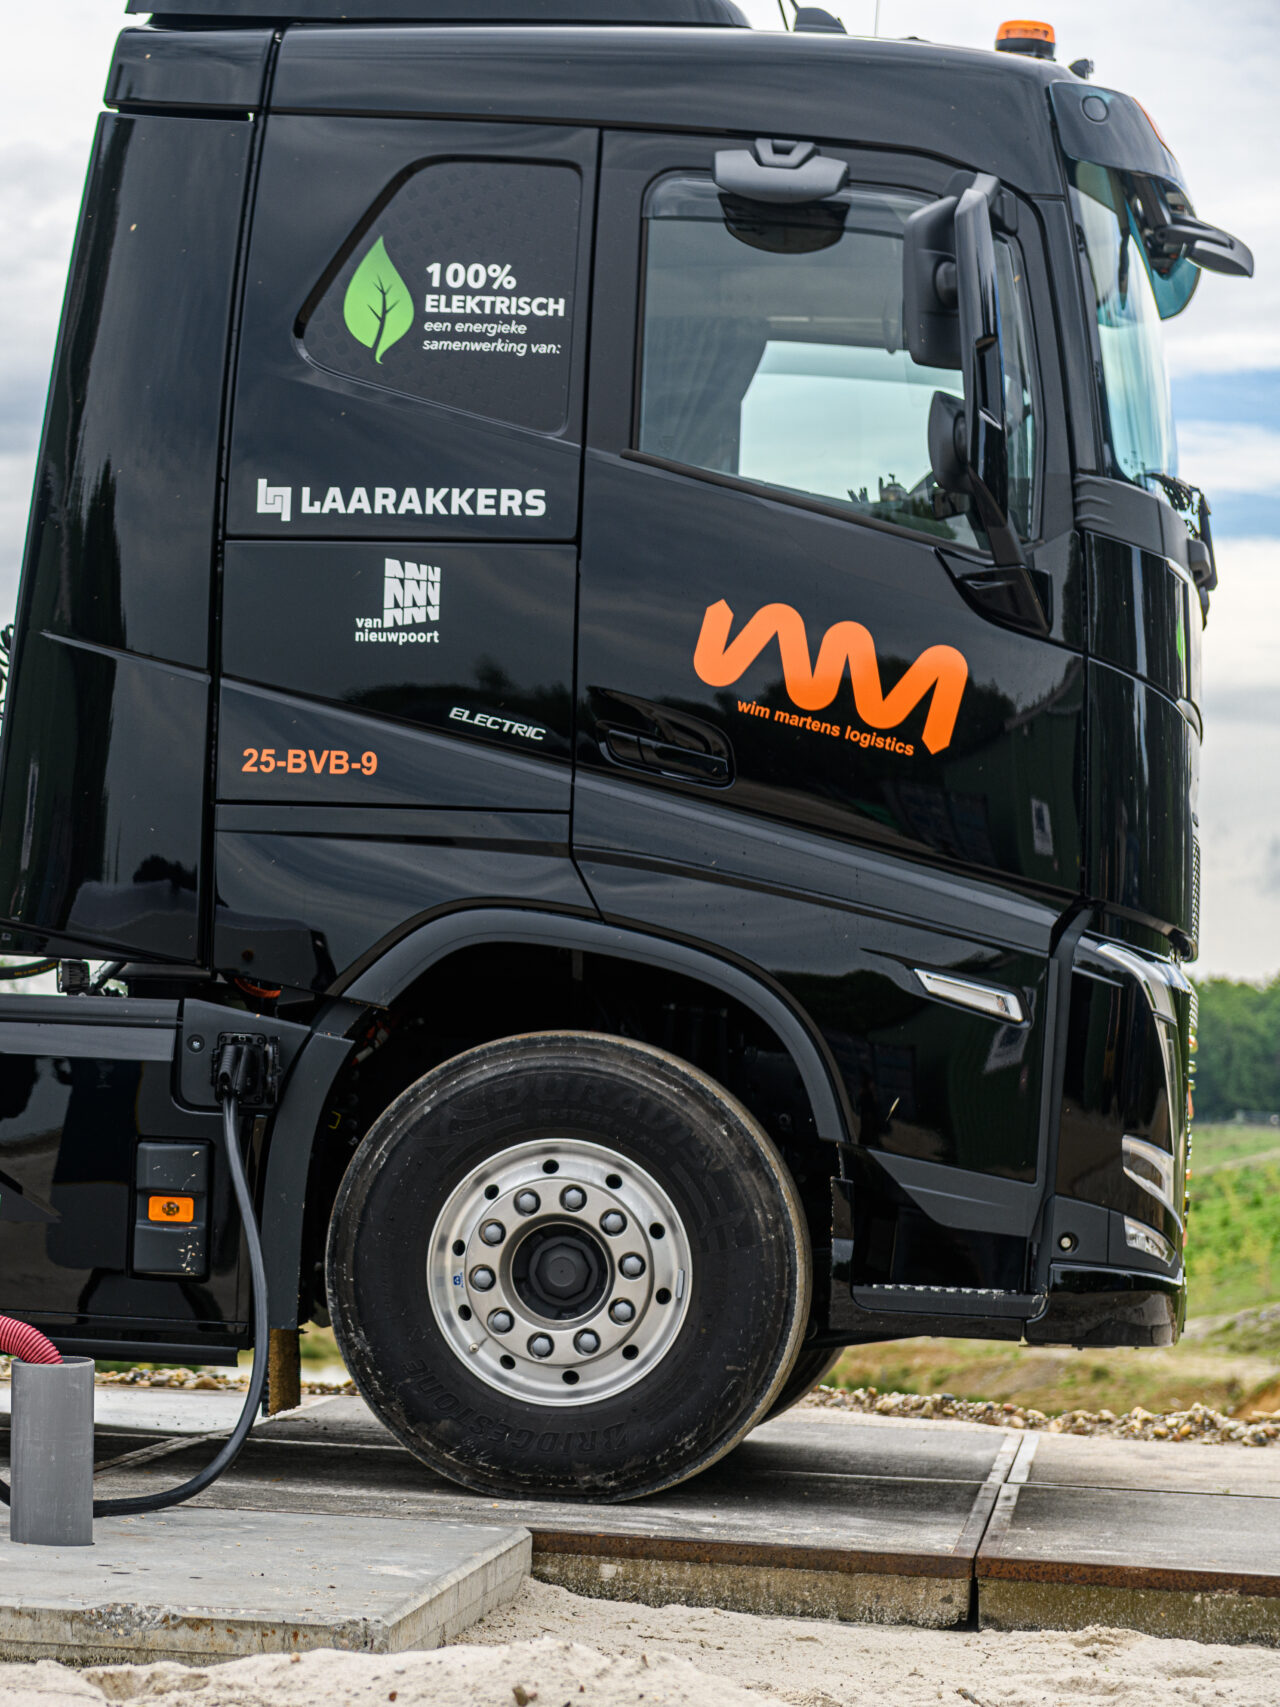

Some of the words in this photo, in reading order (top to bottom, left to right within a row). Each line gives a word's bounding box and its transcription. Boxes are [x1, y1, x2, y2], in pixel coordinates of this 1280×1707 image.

[426, 262, 517, 290] 100%
[425, 294, 566, 317] ELEKTRISCH
[424, 321, 452, 332] een
[455, 320, 528, 337] energieke
[422, 338, 528, 357] samenwerking
[531, 343, 562, 355] van:
[301, 486, 547, 517] LAARAKKERS
[356, 617, 383, 629] van
[355, 629, 440, 646] nieuwpoort
[449, 706, 547, 741] ELECTRIC
[737, 699, 771, 719] wim
[773, 709, 841, 737] martens
[844, 725, 915, 757] logistics
[241, 747, 379, 776] 25-BVB-9
[401, 1355, 630, 1457] BRIDGESTONE
